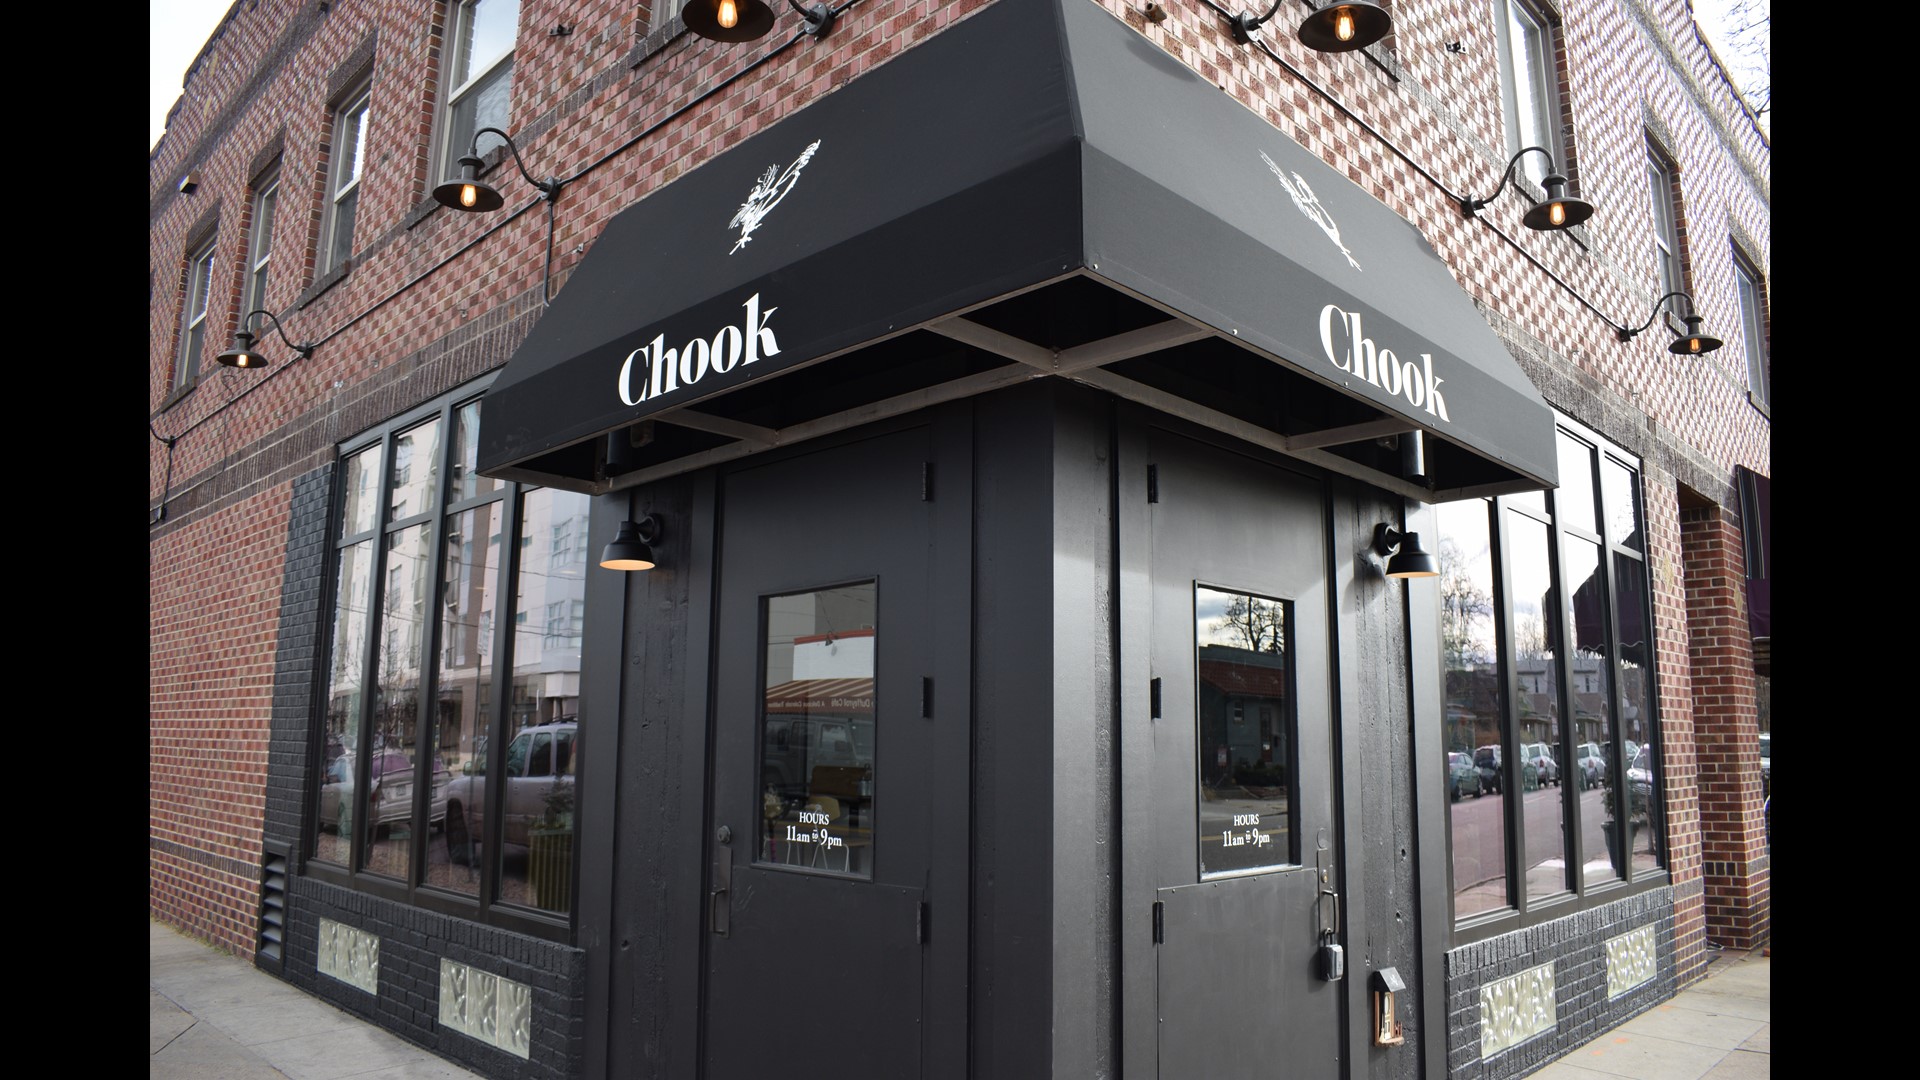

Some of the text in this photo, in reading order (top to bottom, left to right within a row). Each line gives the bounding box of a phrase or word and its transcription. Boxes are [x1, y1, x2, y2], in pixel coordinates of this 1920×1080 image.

[618, 292, 781, 406] Chook
[1319, 304, 1450, 423] Chook
[799, 812, 830, 825] HOURS
[1233, 813, 1260, 826] HOURS
[786, 825, 810, 843] 11am
[820, 828, 842, 849] 9pm
[1222, 830, 1245, 847] 11am
[1252, 828, 1270, 848] 9pm
